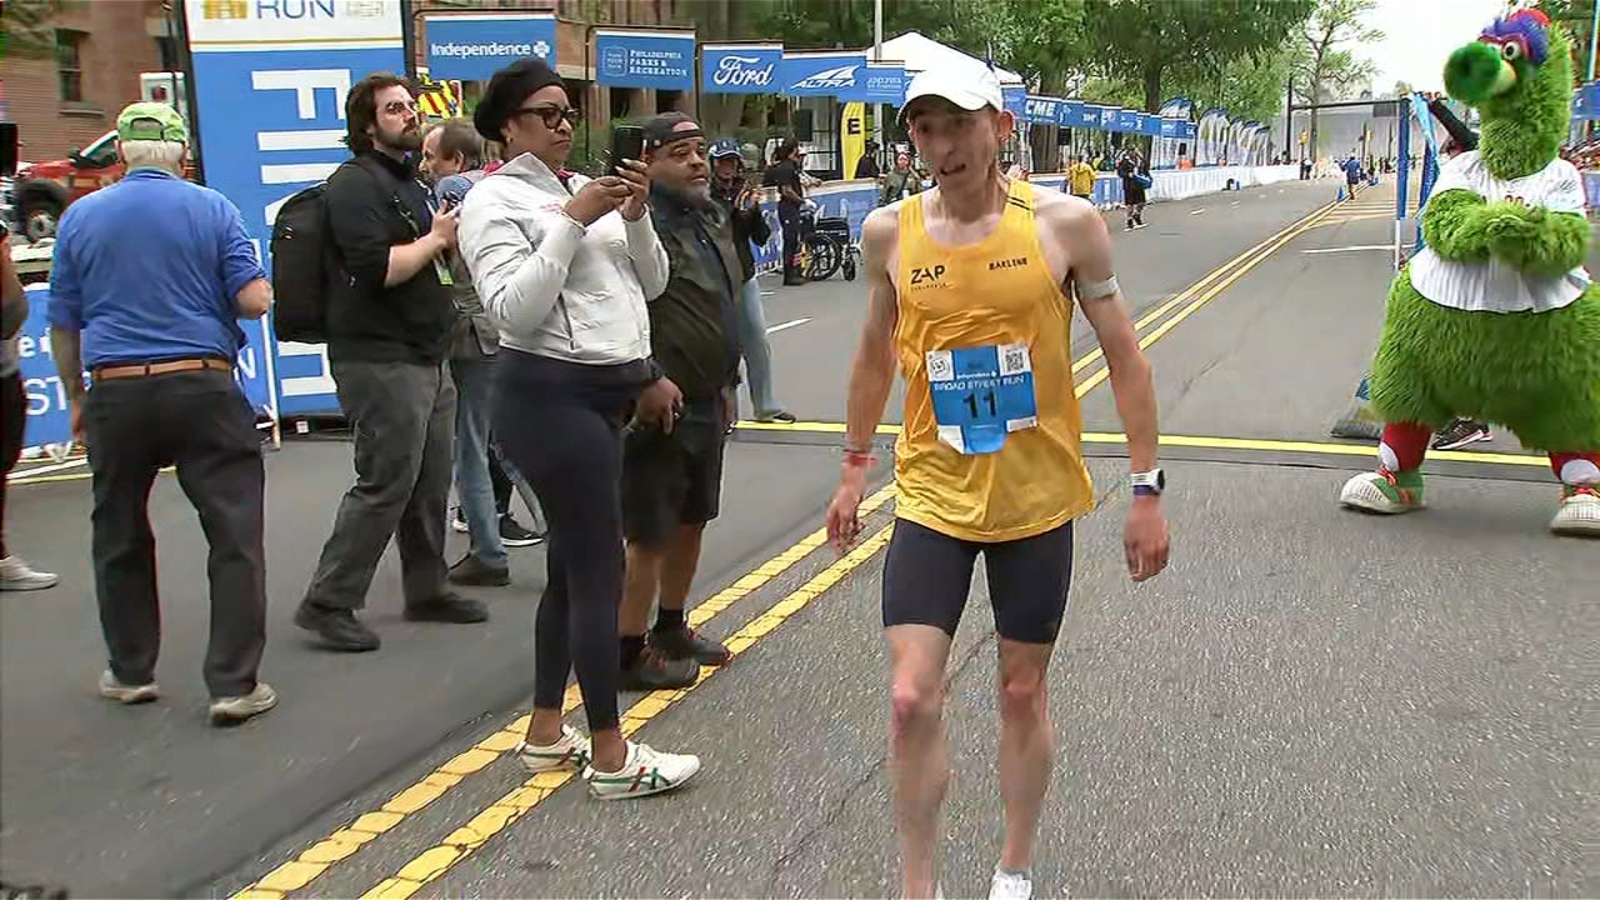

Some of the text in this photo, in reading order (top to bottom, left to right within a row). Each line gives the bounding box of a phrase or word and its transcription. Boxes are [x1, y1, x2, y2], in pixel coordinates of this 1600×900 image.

[256, 0, 335, 19] RUN
[431, 42, 531, 59] Independence
[629, 59, 659, 67] PARKS
[629, 66, 688, 76] RECREATION
[713, 55, 774, 86] Ford
[790, 79, 857, 90] ALTRA
[1025, 100, 1056, 117] CME
[847, 118, 860, 135] E
[911, 264, 945, 284] ZAP
[934, 375, 1025, 391] BROAD STREET RUN
[963, 390, 997, 418] 11
